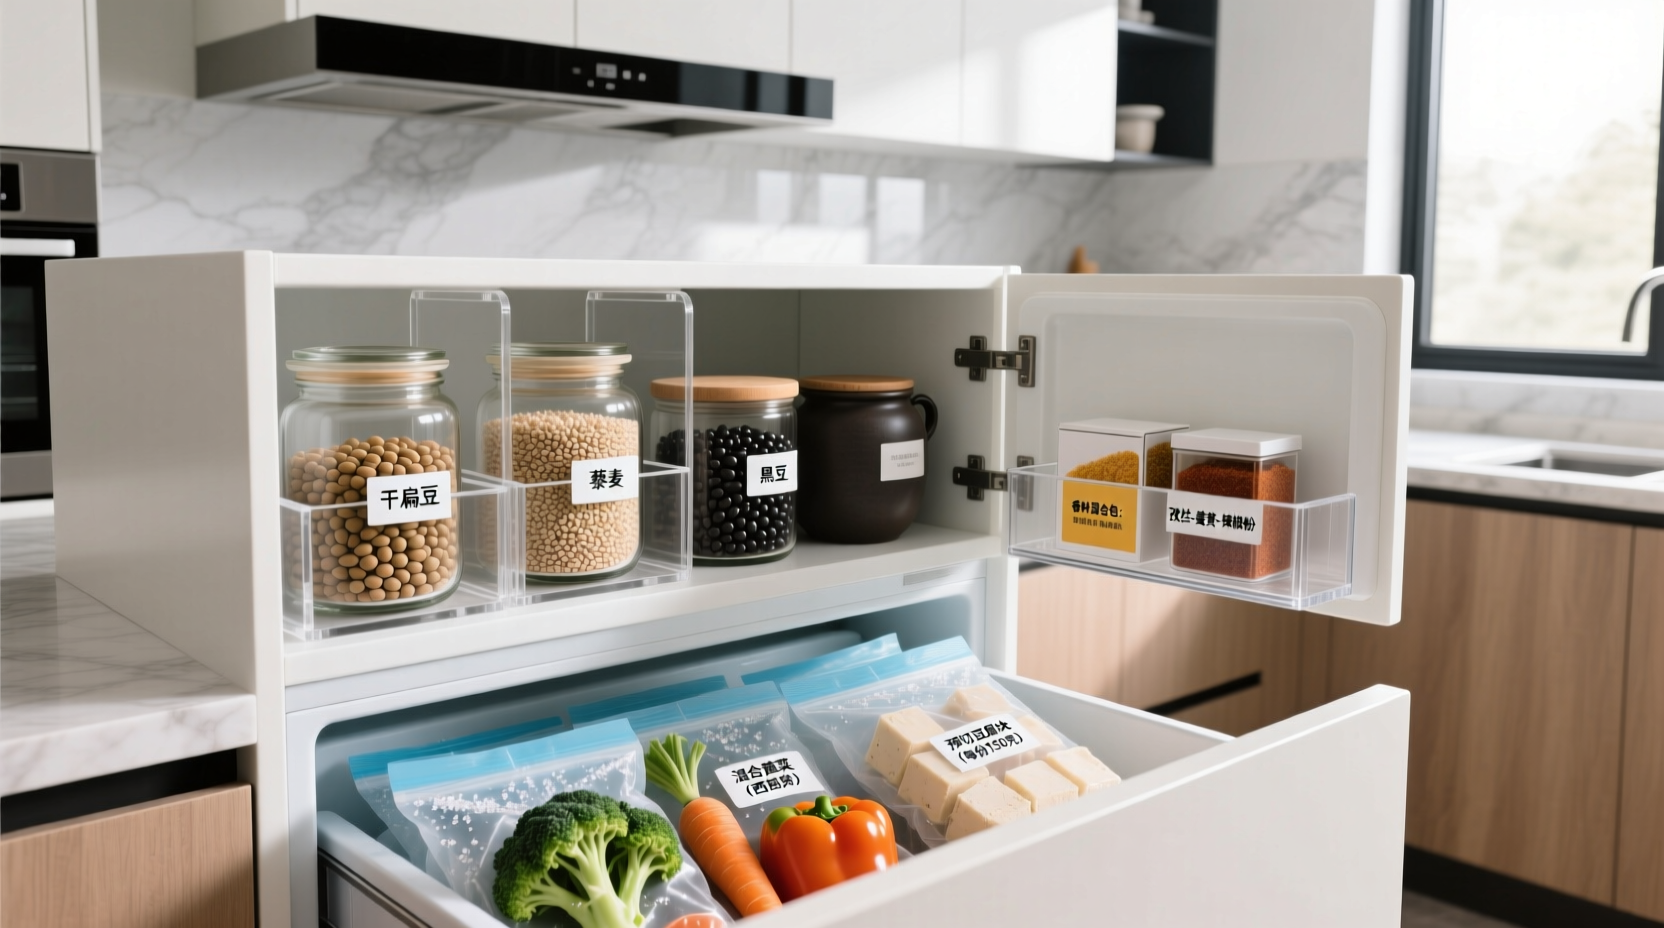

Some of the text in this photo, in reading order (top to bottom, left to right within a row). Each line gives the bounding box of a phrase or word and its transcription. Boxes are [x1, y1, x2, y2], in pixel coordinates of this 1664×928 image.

[589, 468, 624, 490] 藜麦
[380, 485, 440, 510] 干扁豆
